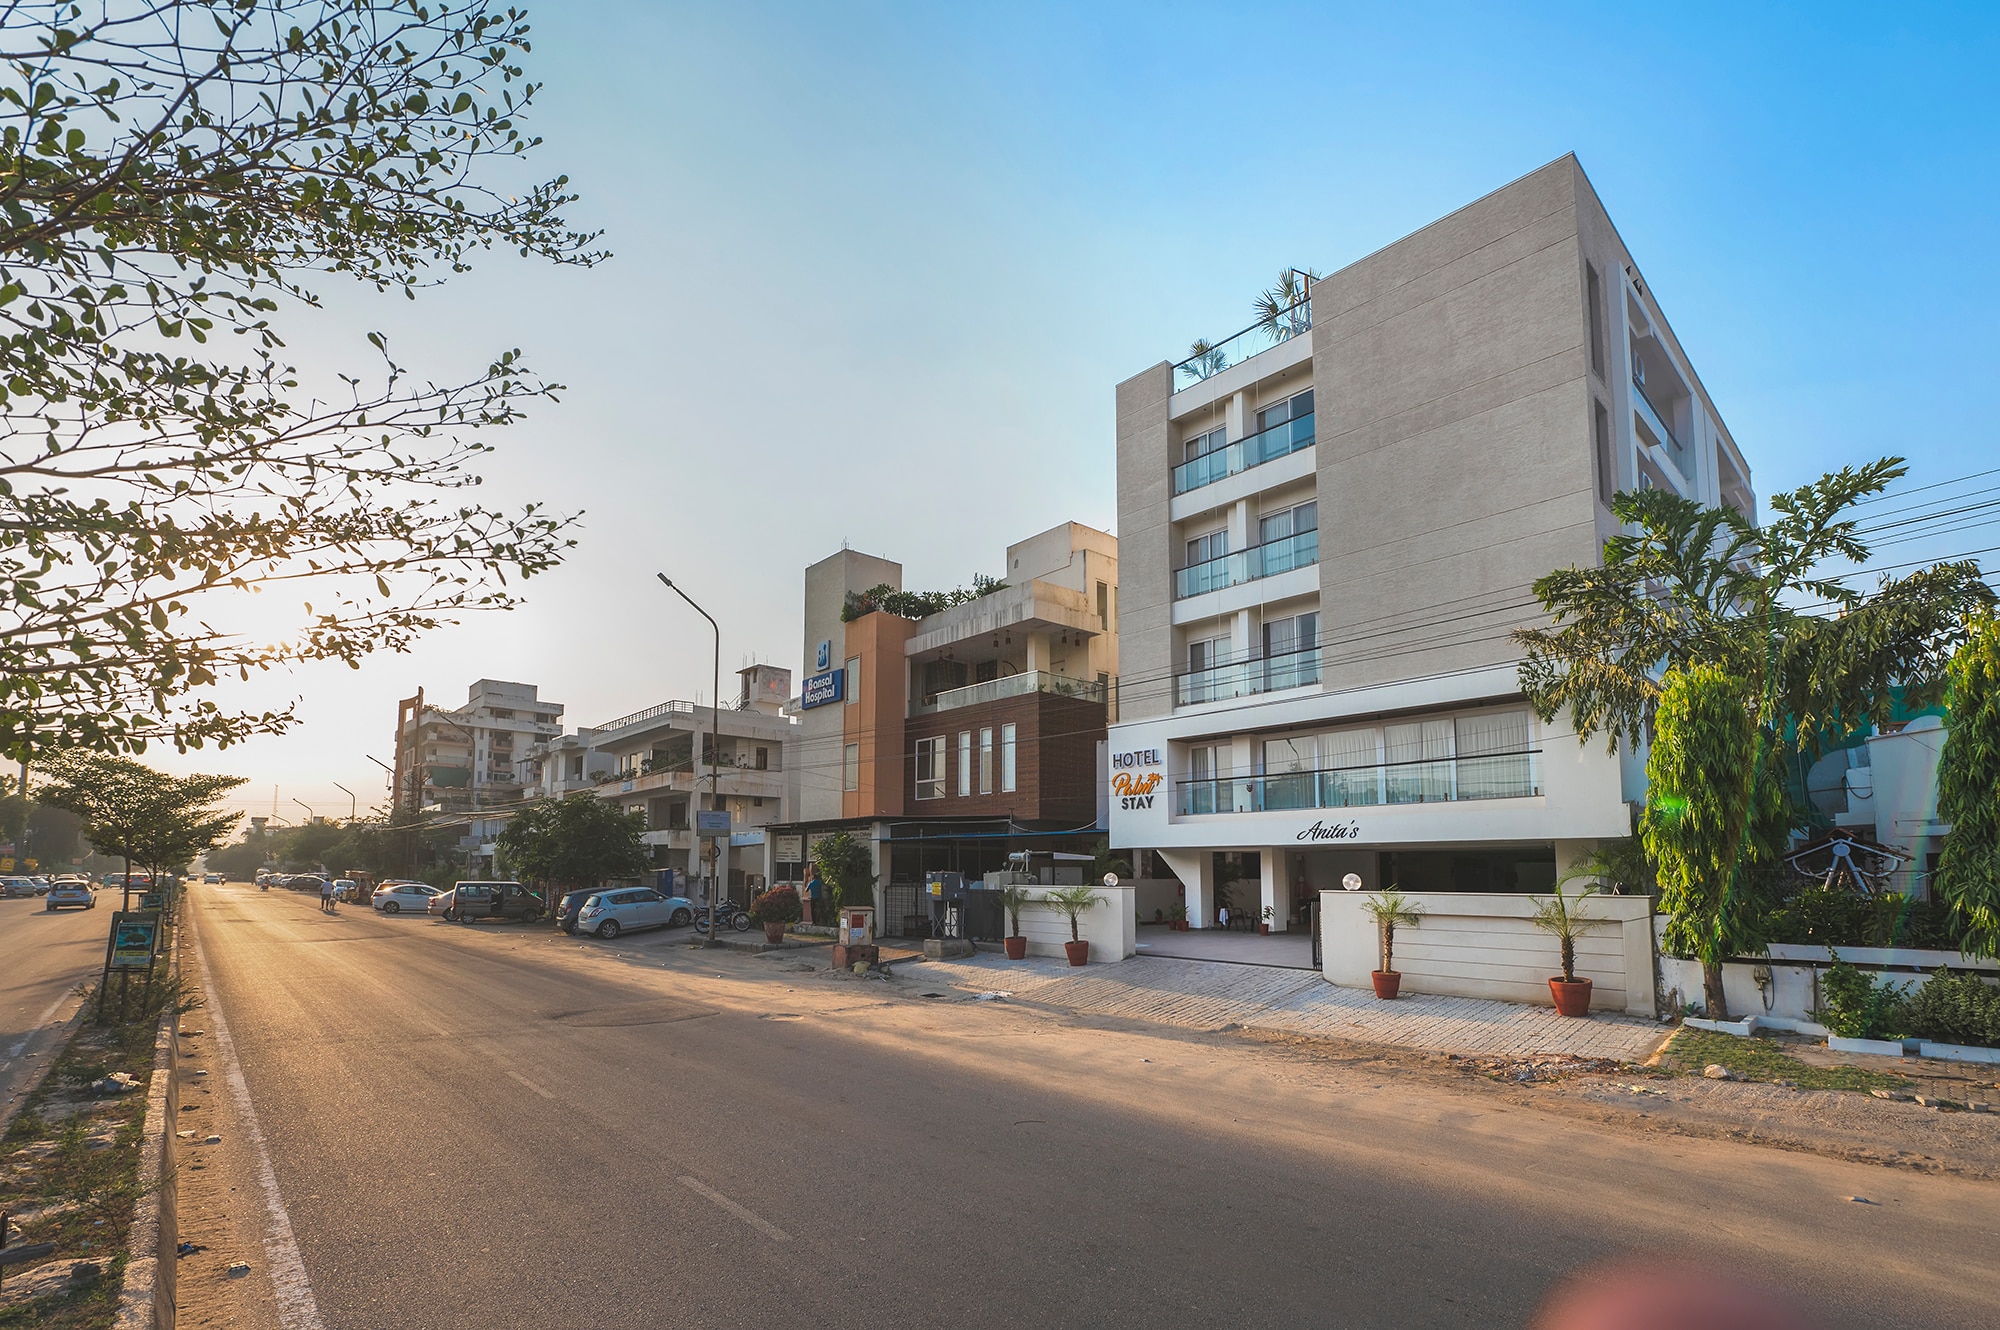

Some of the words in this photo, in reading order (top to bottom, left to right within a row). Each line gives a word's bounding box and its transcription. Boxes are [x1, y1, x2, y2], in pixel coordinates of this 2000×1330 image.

[808, 673, 832, 691] Bansal
[805, 685, 835, 704] Hospital
[1112, 749, 1161, 769] HOTEL
[1111, 772, 1163, 797] Palm
[1121, 795, 1154, 810] STAY
[1296, 820, 1359, 841] Anita's
